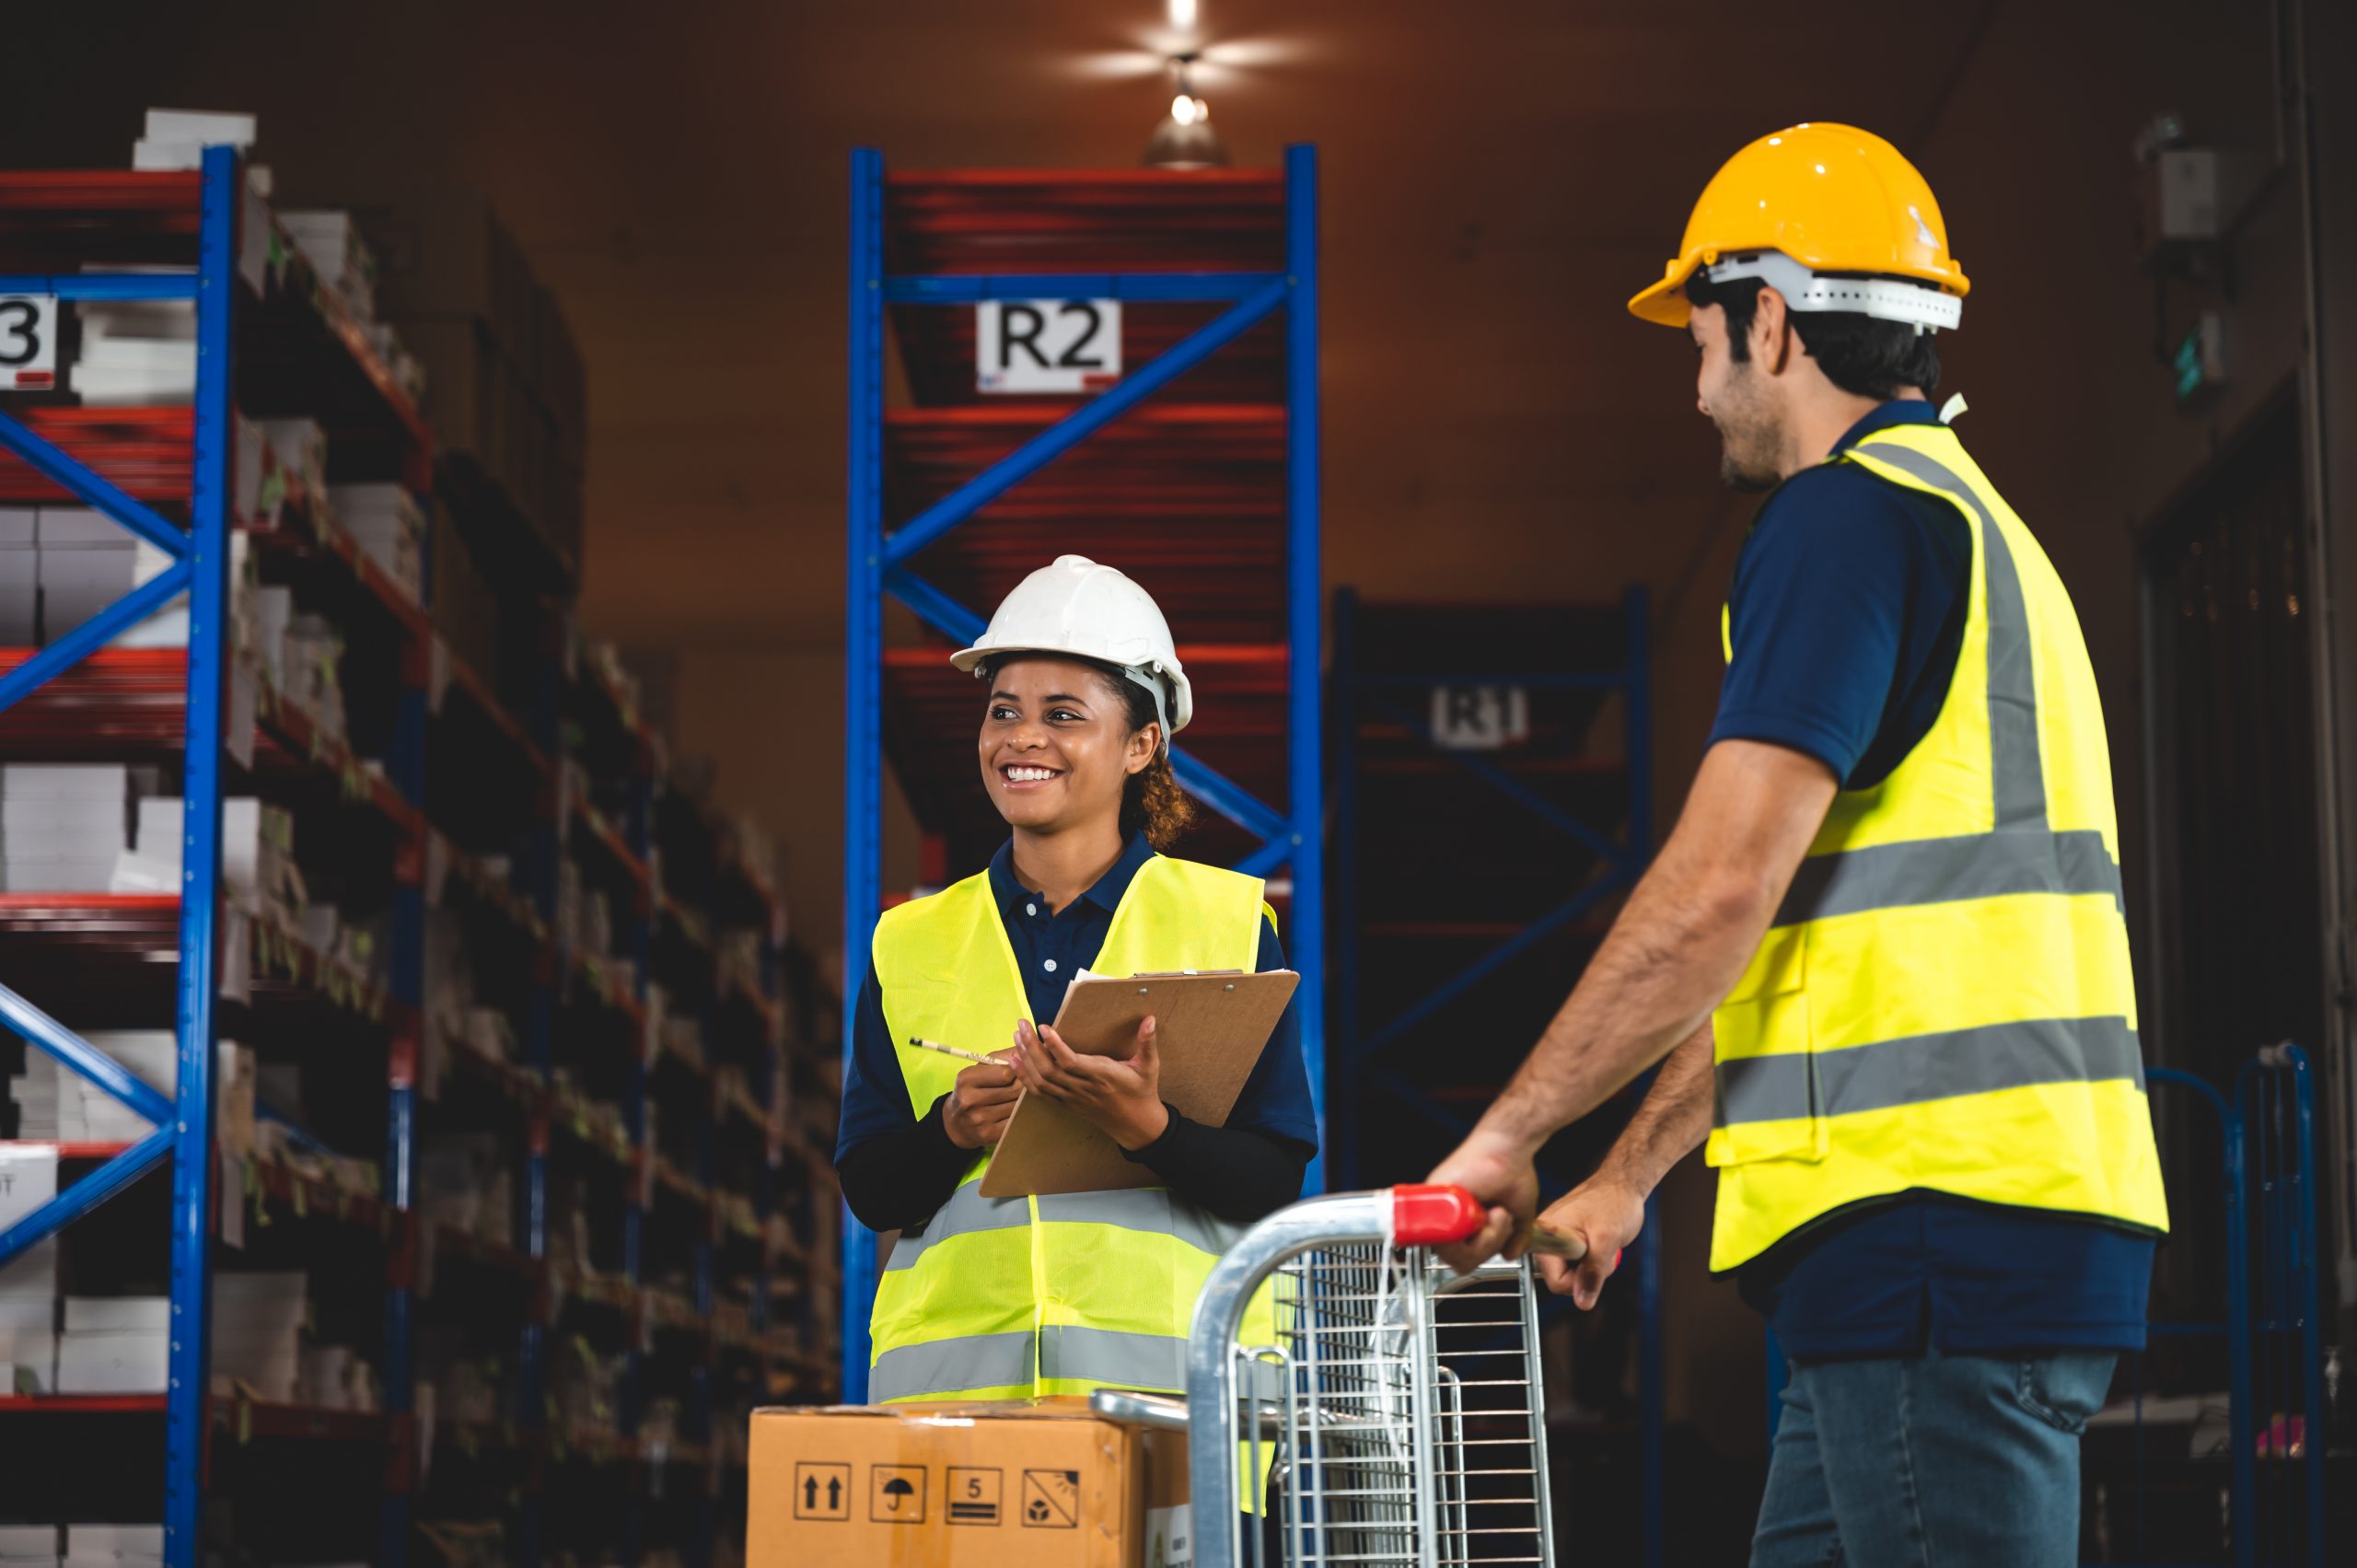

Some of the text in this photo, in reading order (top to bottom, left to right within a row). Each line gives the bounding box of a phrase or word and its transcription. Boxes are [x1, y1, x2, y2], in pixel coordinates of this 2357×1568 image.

[0, 299, 40, 365] 3
[999, 301, 1103, 368] R2
[968, 1477, 982, 1499] 5
